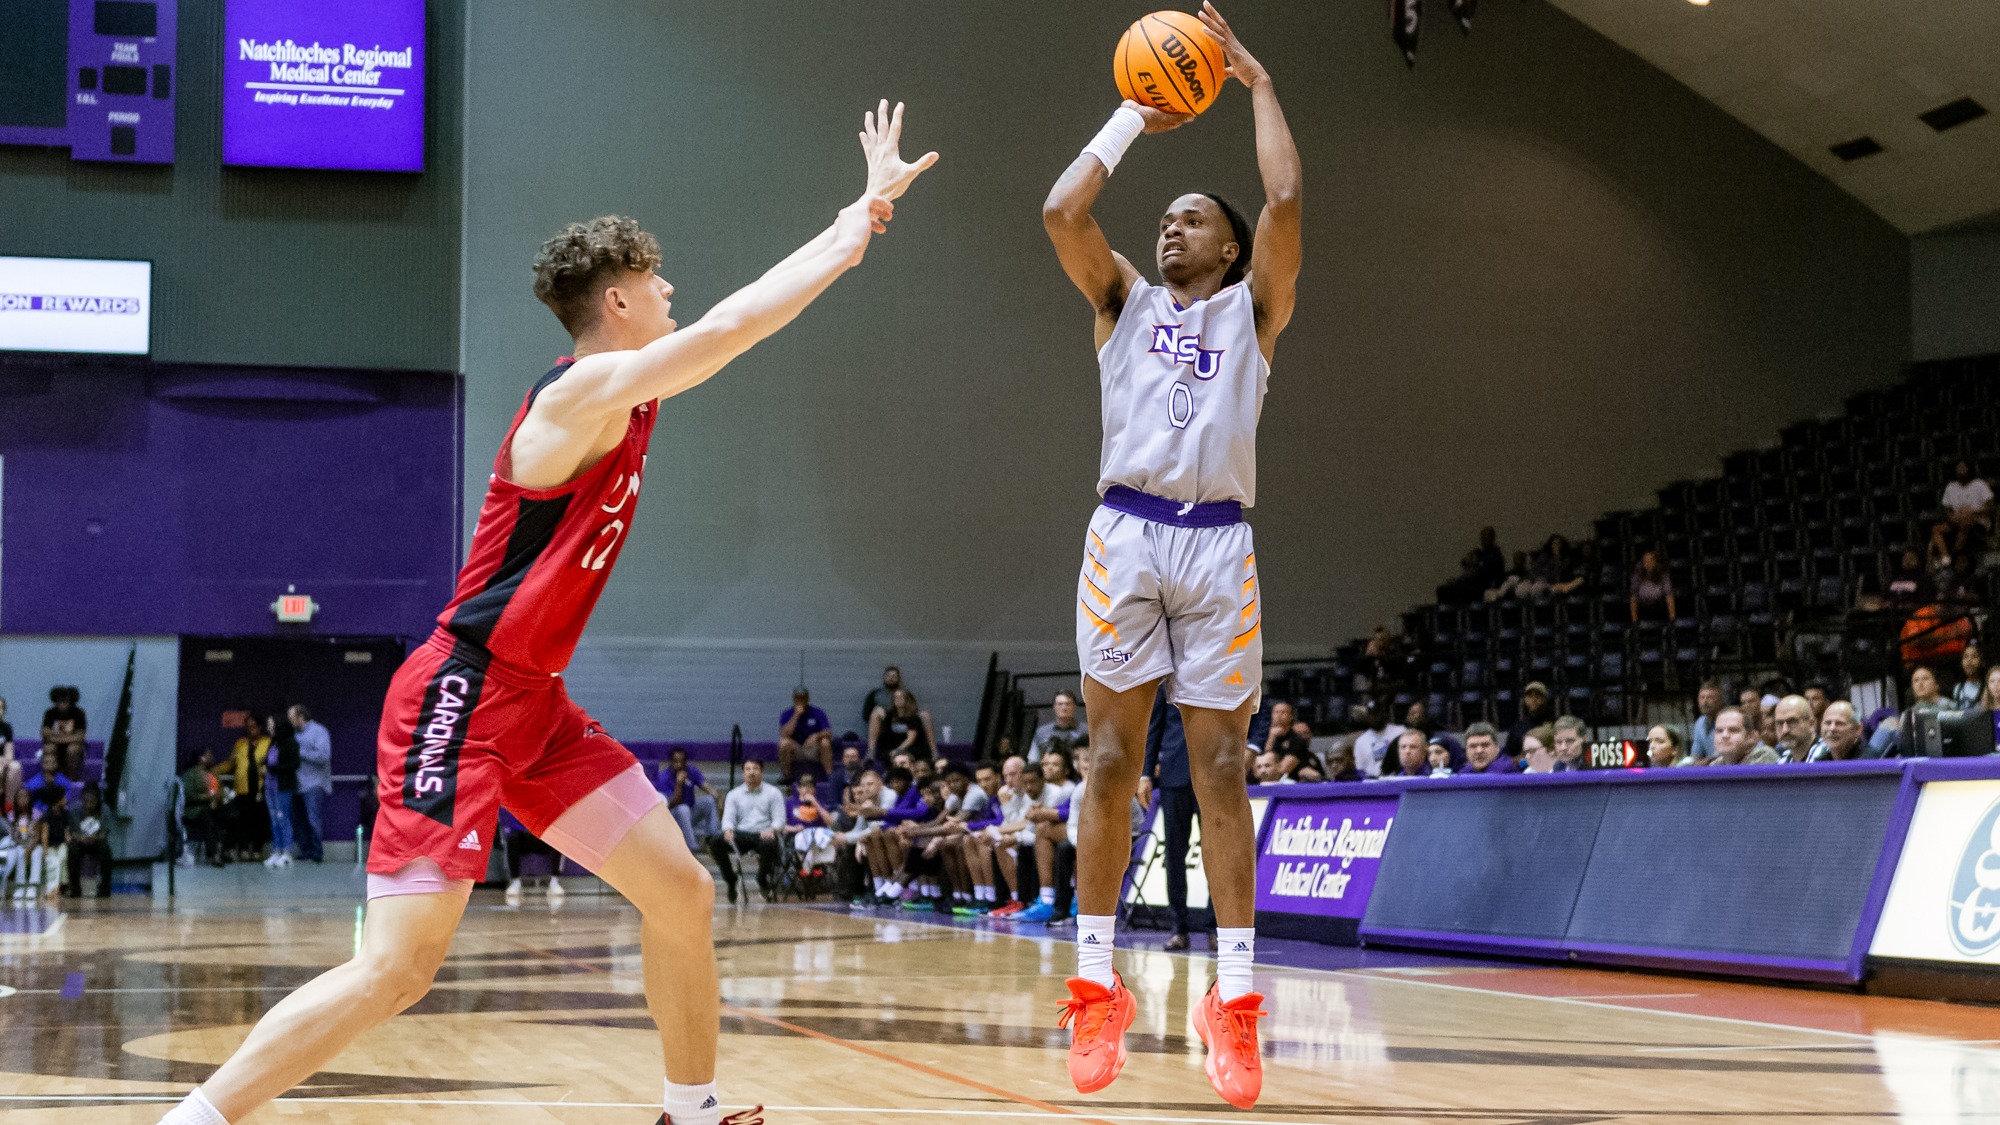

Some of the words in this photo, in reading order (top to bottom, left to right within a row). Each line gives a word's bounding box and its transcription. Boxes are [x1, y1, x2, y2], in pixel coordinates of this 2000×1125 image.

[239, 38, 341, 64] Natchitoches
[342, 43, 413, 70] Regional
[1161, 33, 1206, 105] Wilson
[270, 61, 329, 84] Medical
[331, 64, 382, 86] Center
[254, 91, 299, 106] Inspiring
[299, 93, 350, 107] Excellence
[350, 95, 394, 110] Everyday
[42, 296, 139, 313] REWARDS
[1148, 324, 1225, 381] NSU
[1168, 380, 1194, 430] 0
[283, 597, 307, 614] EXIT
[1101, 648, 1133, 664] NSU
[1265, 815, 1338, 857] Natchitoches
[1331, 817, 1393, 869] Regional
[1270, 862, 1320, 897] Medical
[1311, 863, 1352, 899] Center
